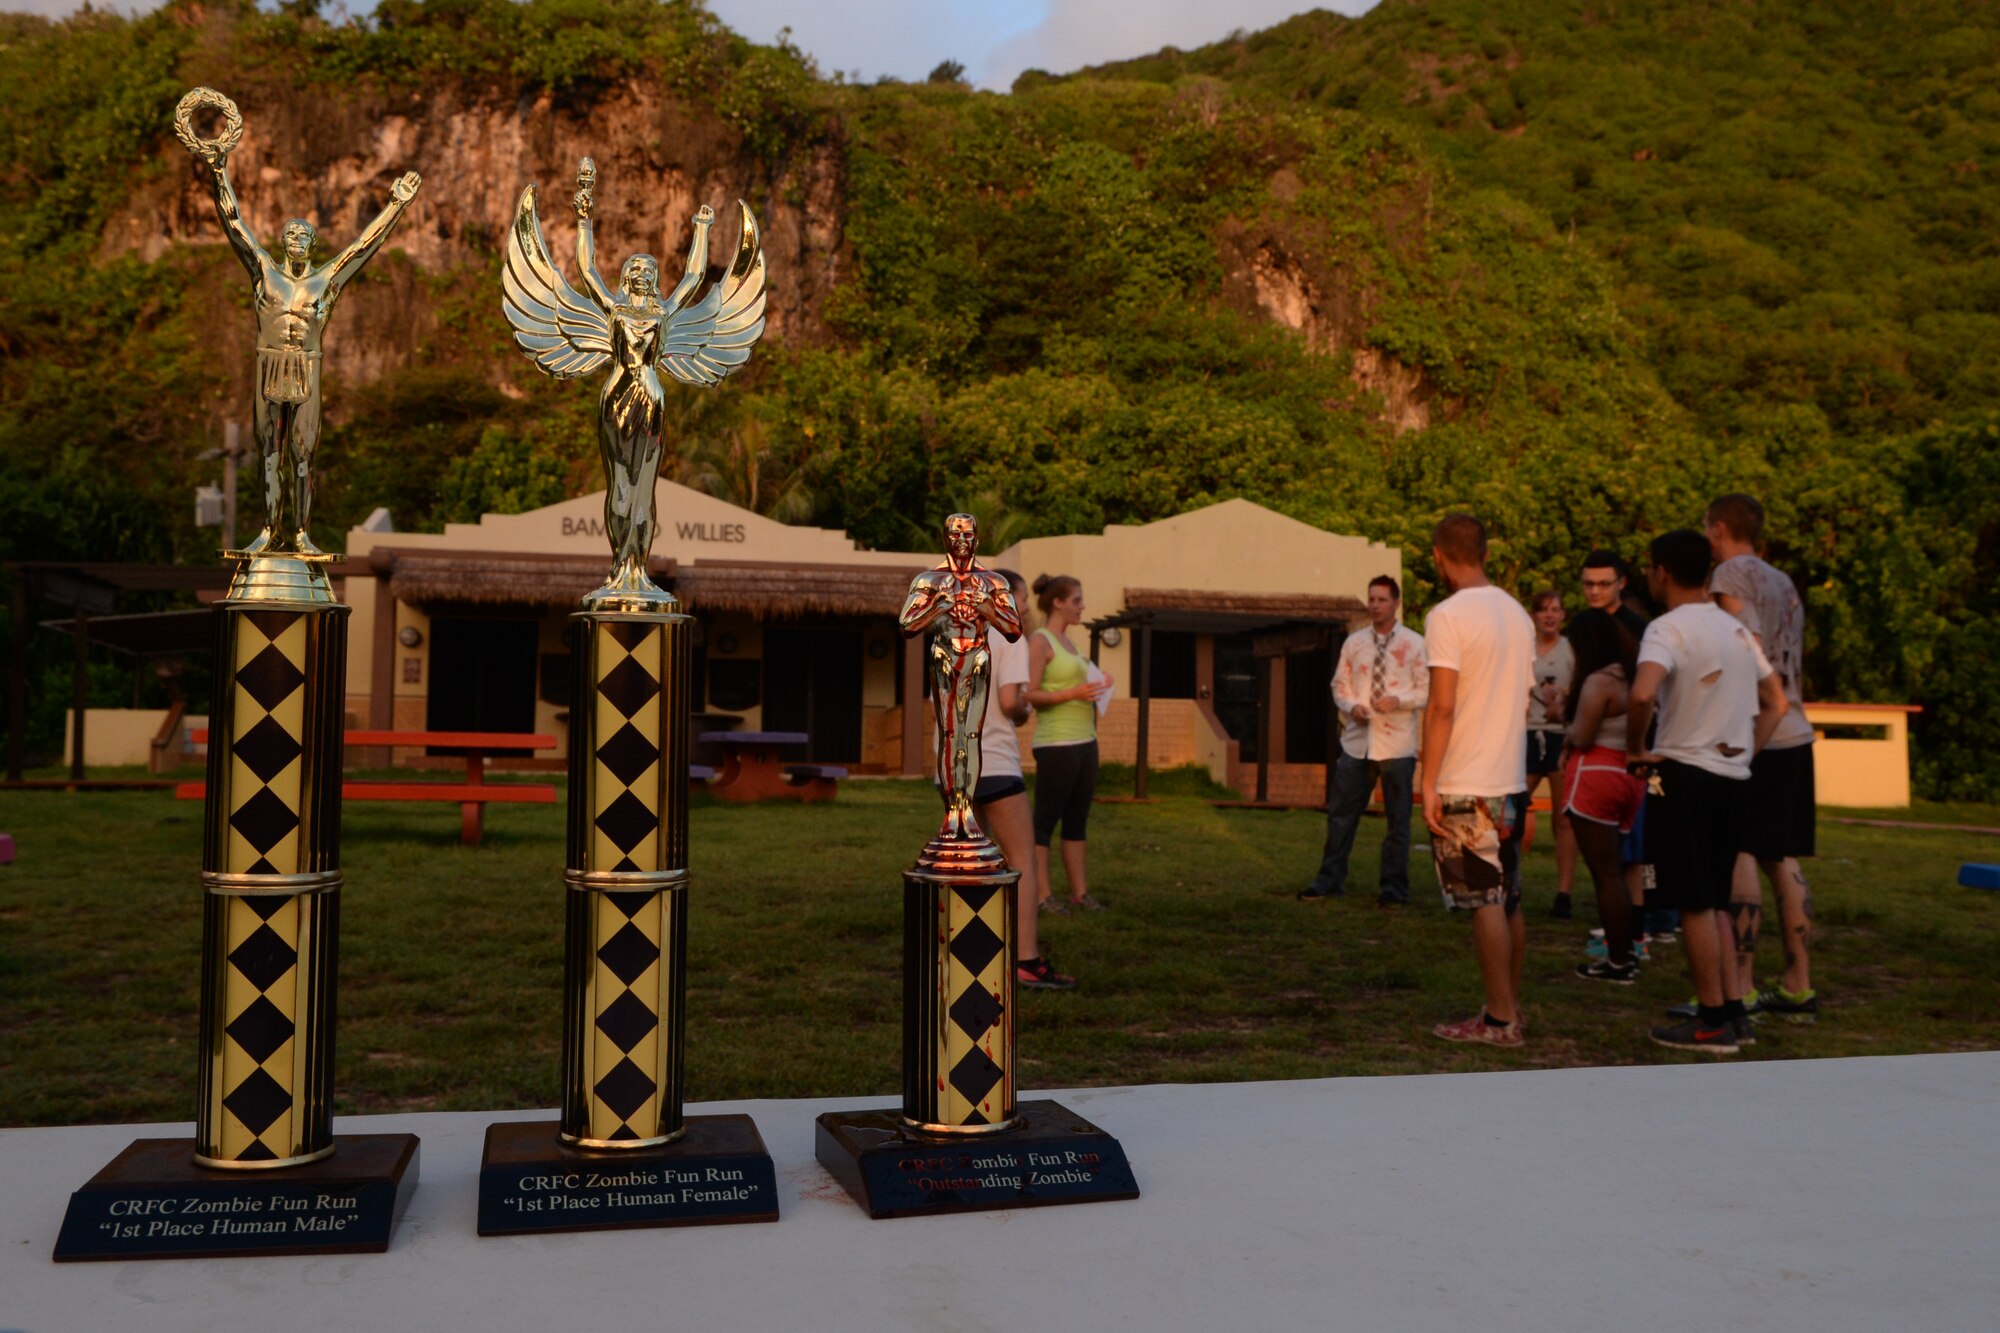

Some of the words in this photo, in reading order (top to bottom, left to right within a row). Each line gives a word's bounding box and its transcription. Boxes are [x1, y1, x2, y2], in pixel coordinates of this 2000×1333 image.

[561, 515, 662, 539] BAM
[676, 521, 746, 543] WILLIES
[1028, 1152, 1061, 1167] Fun
[1065, 1151, 1101, 1165] Run
[518, 1174, 580, 1191] CRFC
[586, 1171, 658, 1188] Zombie
[663, 1169, 700, 1185] Fun
[705, 1167, 744, 1182] Run
[907, 1173, 1024, 1192] “Outstanding
[109, 1199, 177, 1216] CRFC
[181, 1196, 263, 1215] Zombie
[267, 1195, 308, 1212] Fun
[315, 1193, 357, 1211] Run
[503, 1197, 543, 1212] “1st
[548, 1194, 601, 1210] Place
[606, 1191, 677, 1207] Human
[681, 1184, 759, 1204] Female”
[99, 1222, 141, 1238] “1st
[146, 1220, 205, 1237] Place
[210, 1217, 288, 1235] Human
[293, 1213, 359, 1233] Male”
